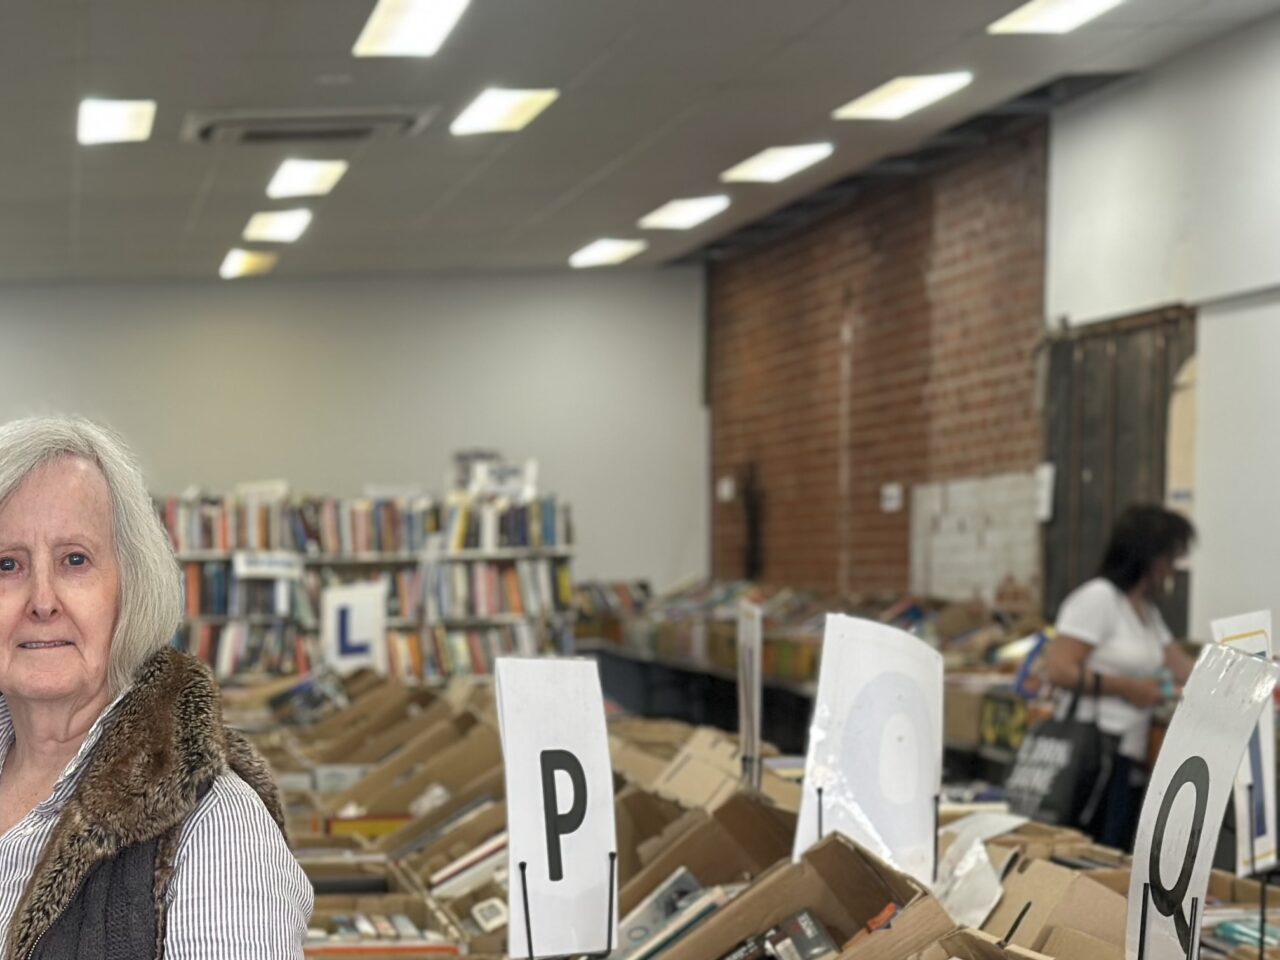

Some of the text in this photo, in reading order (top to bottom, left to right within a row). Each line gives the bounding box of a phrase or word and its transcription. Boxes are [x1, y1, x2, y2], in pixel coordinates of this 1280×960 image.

[337, 603, 371, 657] L
[540, 748, 589, 882] P
[1148, 756, 1211, 955] Q
